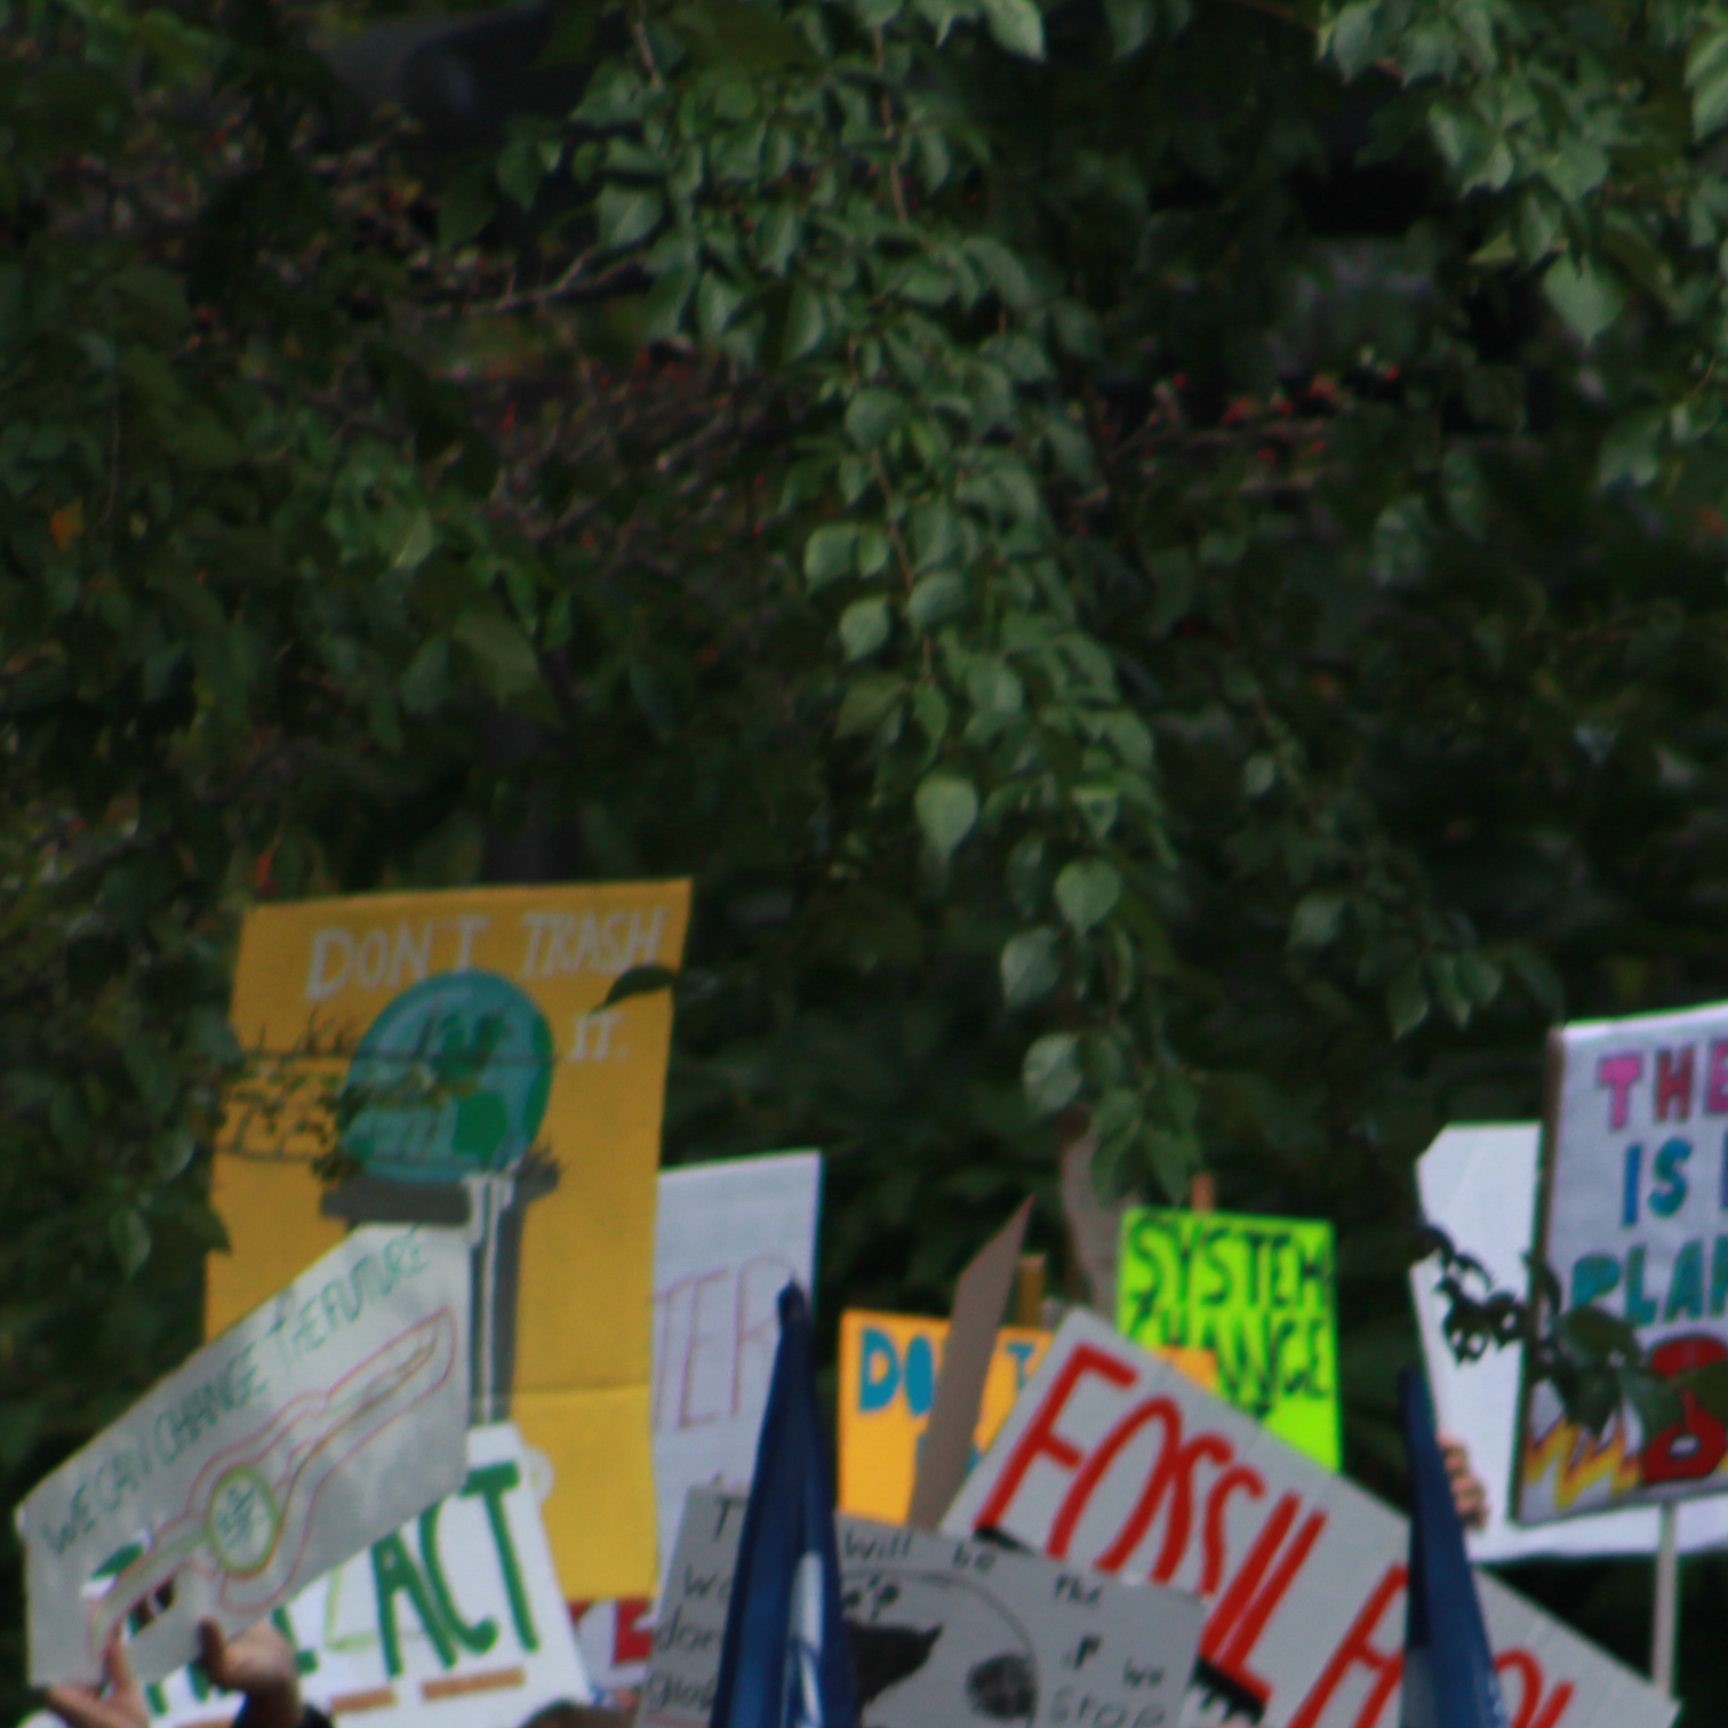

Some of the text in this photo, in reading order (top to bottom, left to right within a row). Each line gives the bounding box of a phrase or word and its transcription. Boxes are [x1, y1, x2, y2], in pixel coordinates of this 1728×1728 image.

[306, 907, 669, 1000] DON'T TRASH
[1622, 1137, 1696, 1228] IS
[371, 1460, 539, 1678] ACT
[975, 1342, 1329, 1704] FOSSIL
